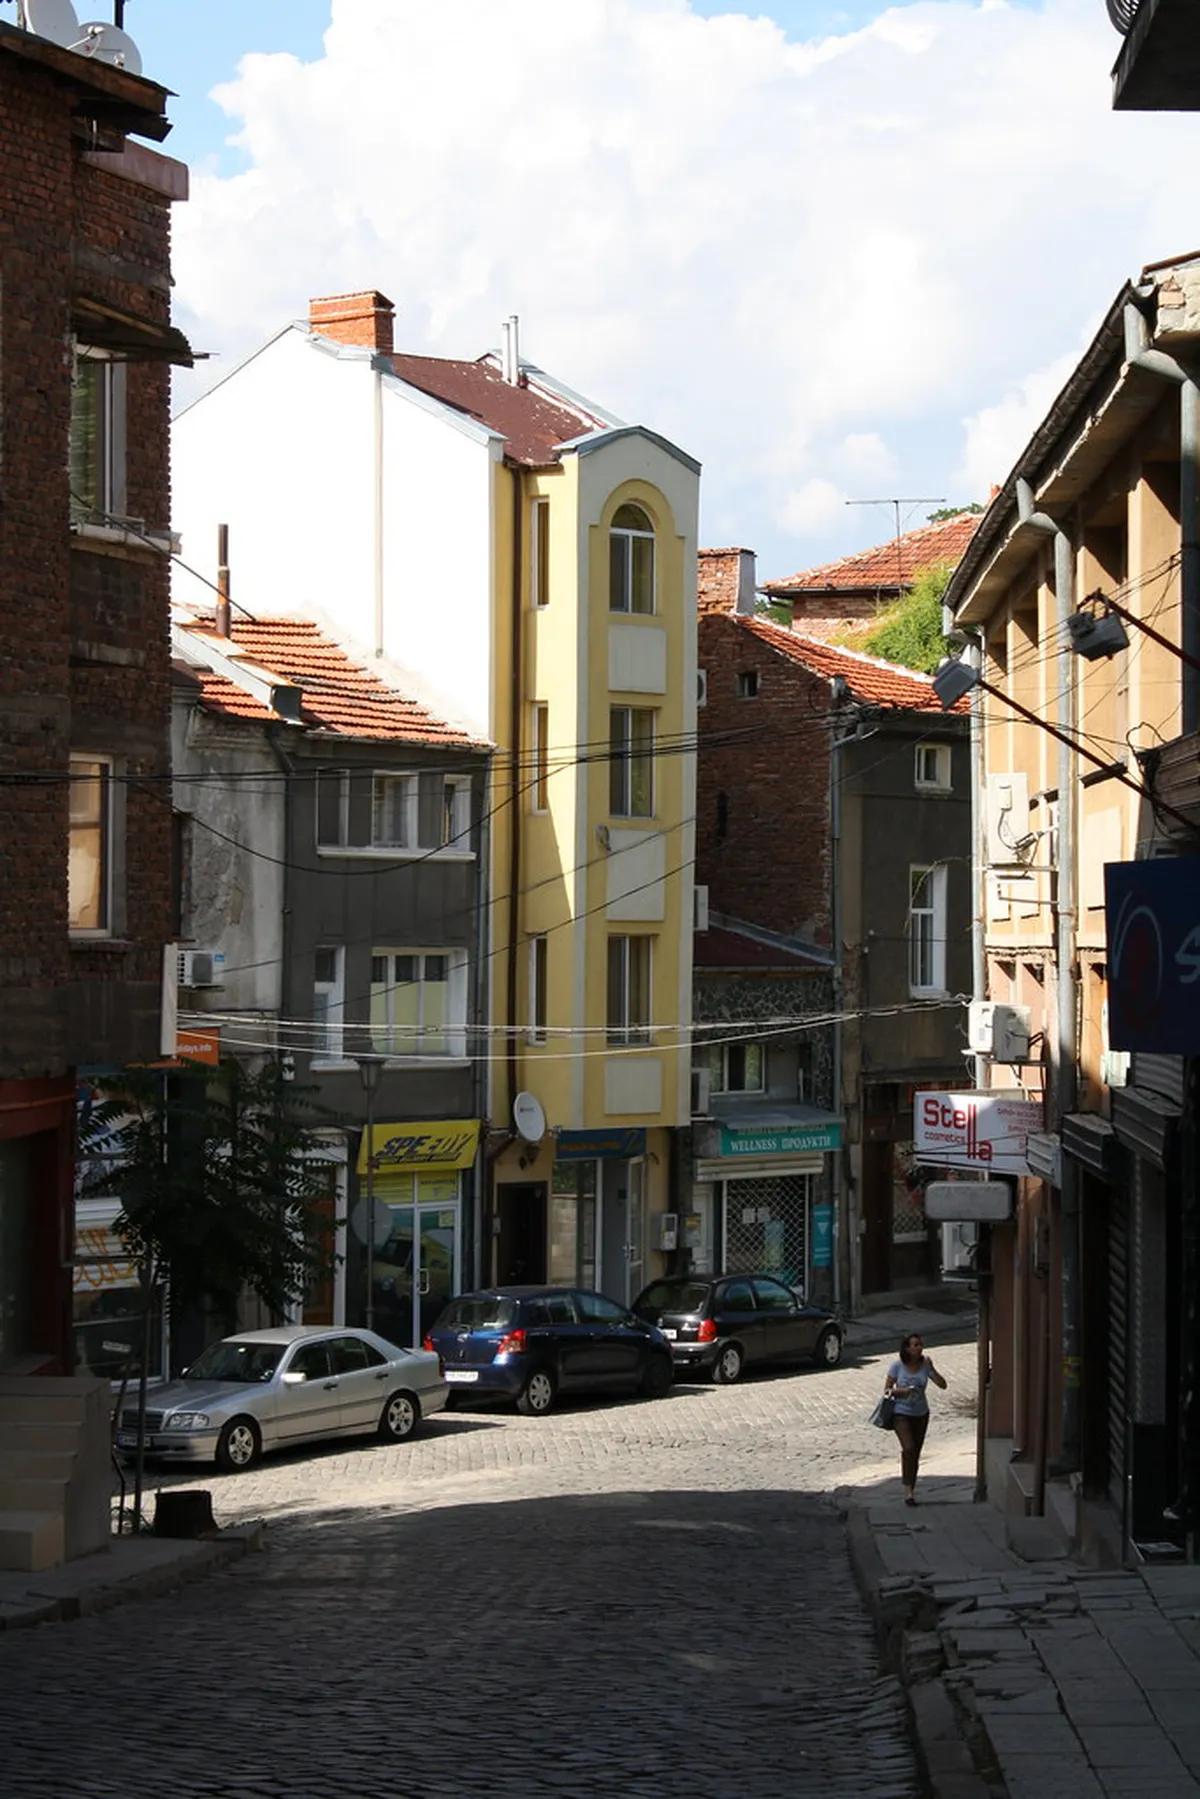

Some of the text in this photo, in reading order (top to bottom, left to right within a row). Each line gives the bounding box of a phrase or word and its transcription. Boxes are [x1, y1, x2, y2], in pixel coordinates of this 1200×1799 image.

[730, 1136, 831, 1152] WELLNESS ПРОДУКТИ
[924, 1131, 966, 1143] cosmetics
